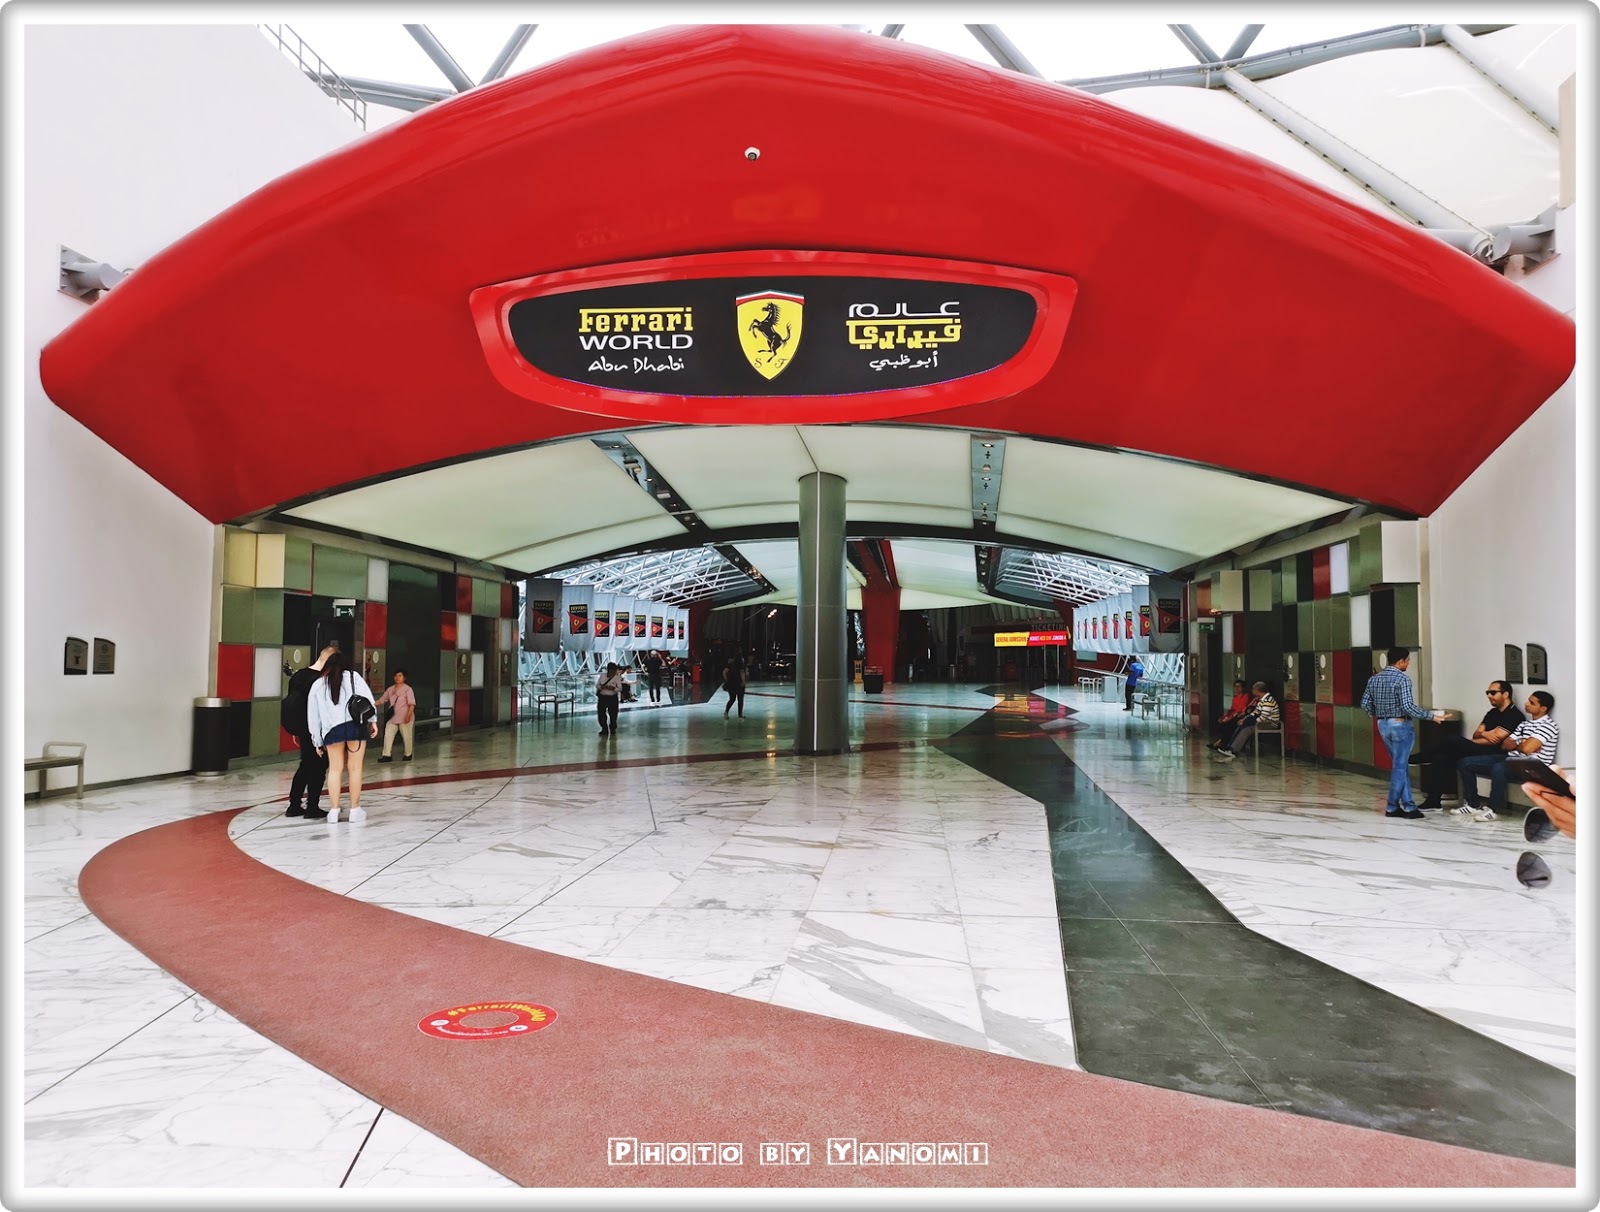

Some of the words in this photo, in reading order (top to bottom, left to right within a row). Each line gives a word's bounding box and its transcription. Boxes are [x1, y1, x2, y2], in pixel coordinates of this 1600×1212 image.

[579, 307, 694, 332] Ferrari
[849, 301, 960, 318] عالم
[579, 334, 694, 350] WORLD
[846, 318, 962, 350] فيراري
[587, 355, 628, 372] Abu
[633, 354, 685, 374] Dhabi
